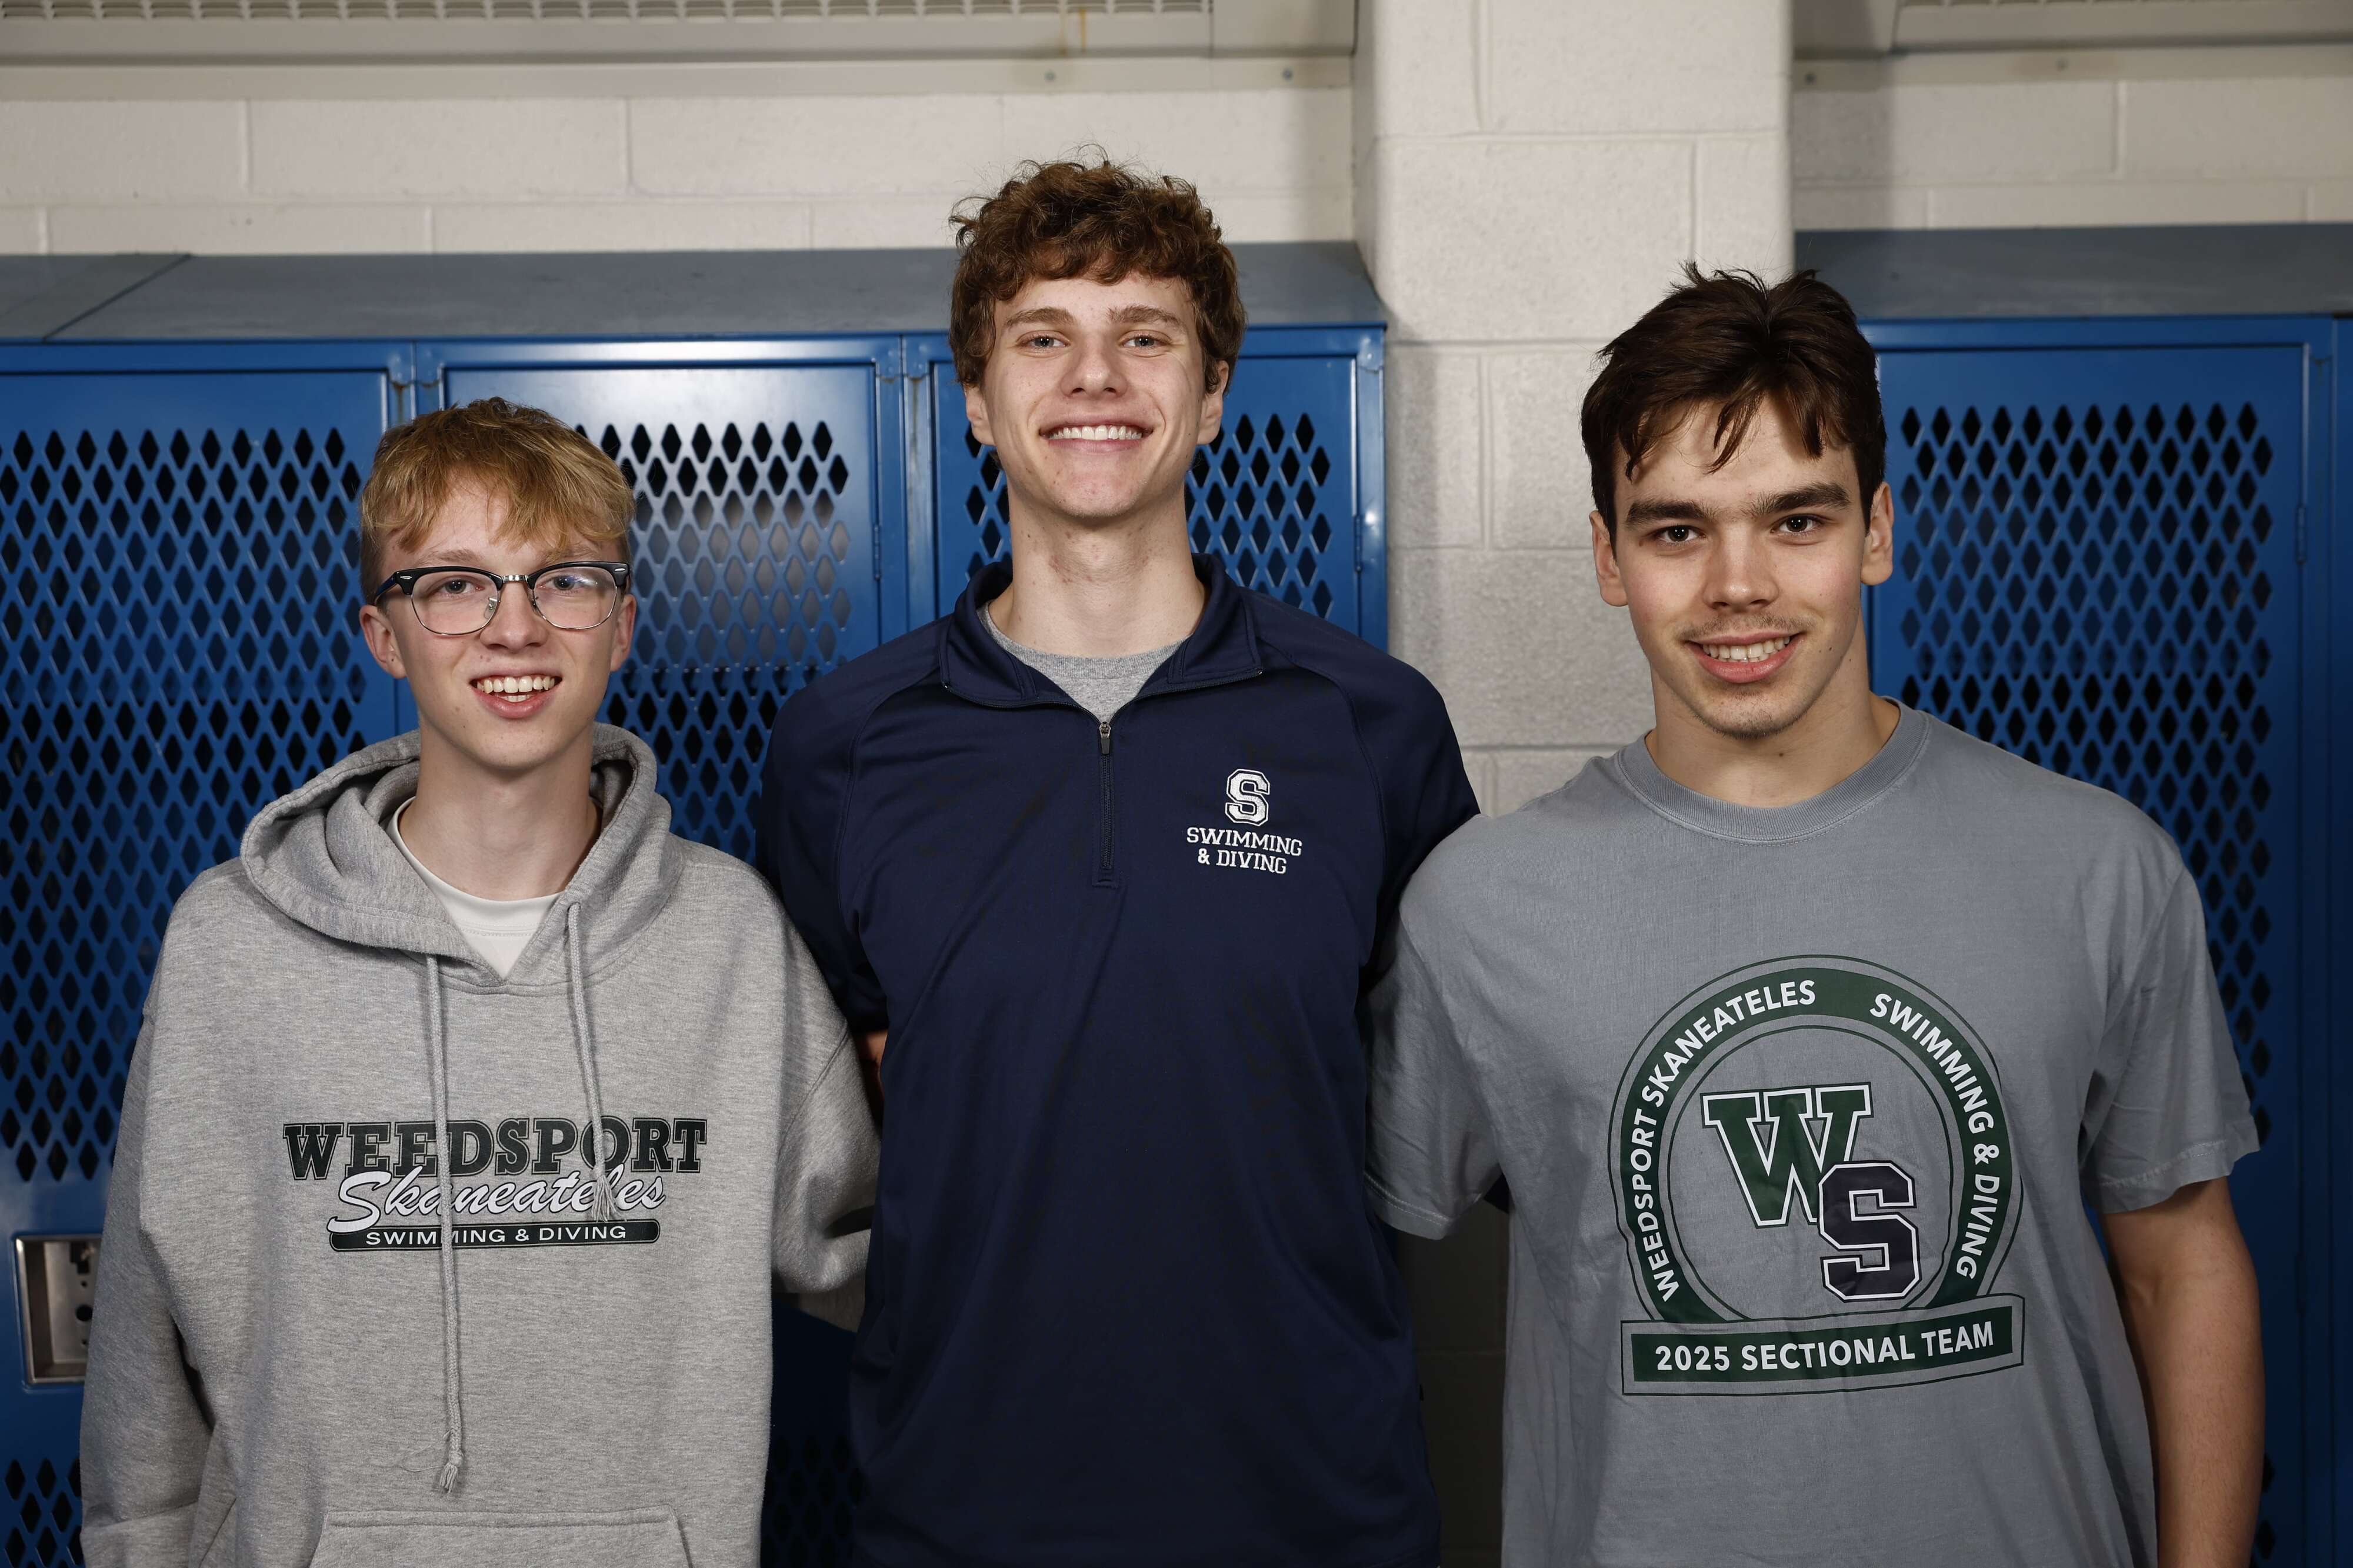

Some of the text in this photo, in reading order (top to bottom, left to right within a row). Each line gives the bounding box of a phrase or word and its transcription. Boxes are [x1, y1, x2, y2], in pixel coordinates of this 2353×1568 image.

[1225, 768, 1271, 827] S
[1187, 827, 1302, 856] SWIMMING
[1197, 848, 1287, 874] & DIVING
[283, 1115, 707, 1180] WEEDSPORT
[1630, 980, 1815, 1302] WEEDSPORT SKANEATELES
[1869, 993, 2000, 1279] SWIMMING & DIVING
[515, 1229, 529, 1242] &
[539, 1226, 626, 1240] DIVING
[1655, 1321, 1994, 1371] 2025 SECTIONAL TEAM
